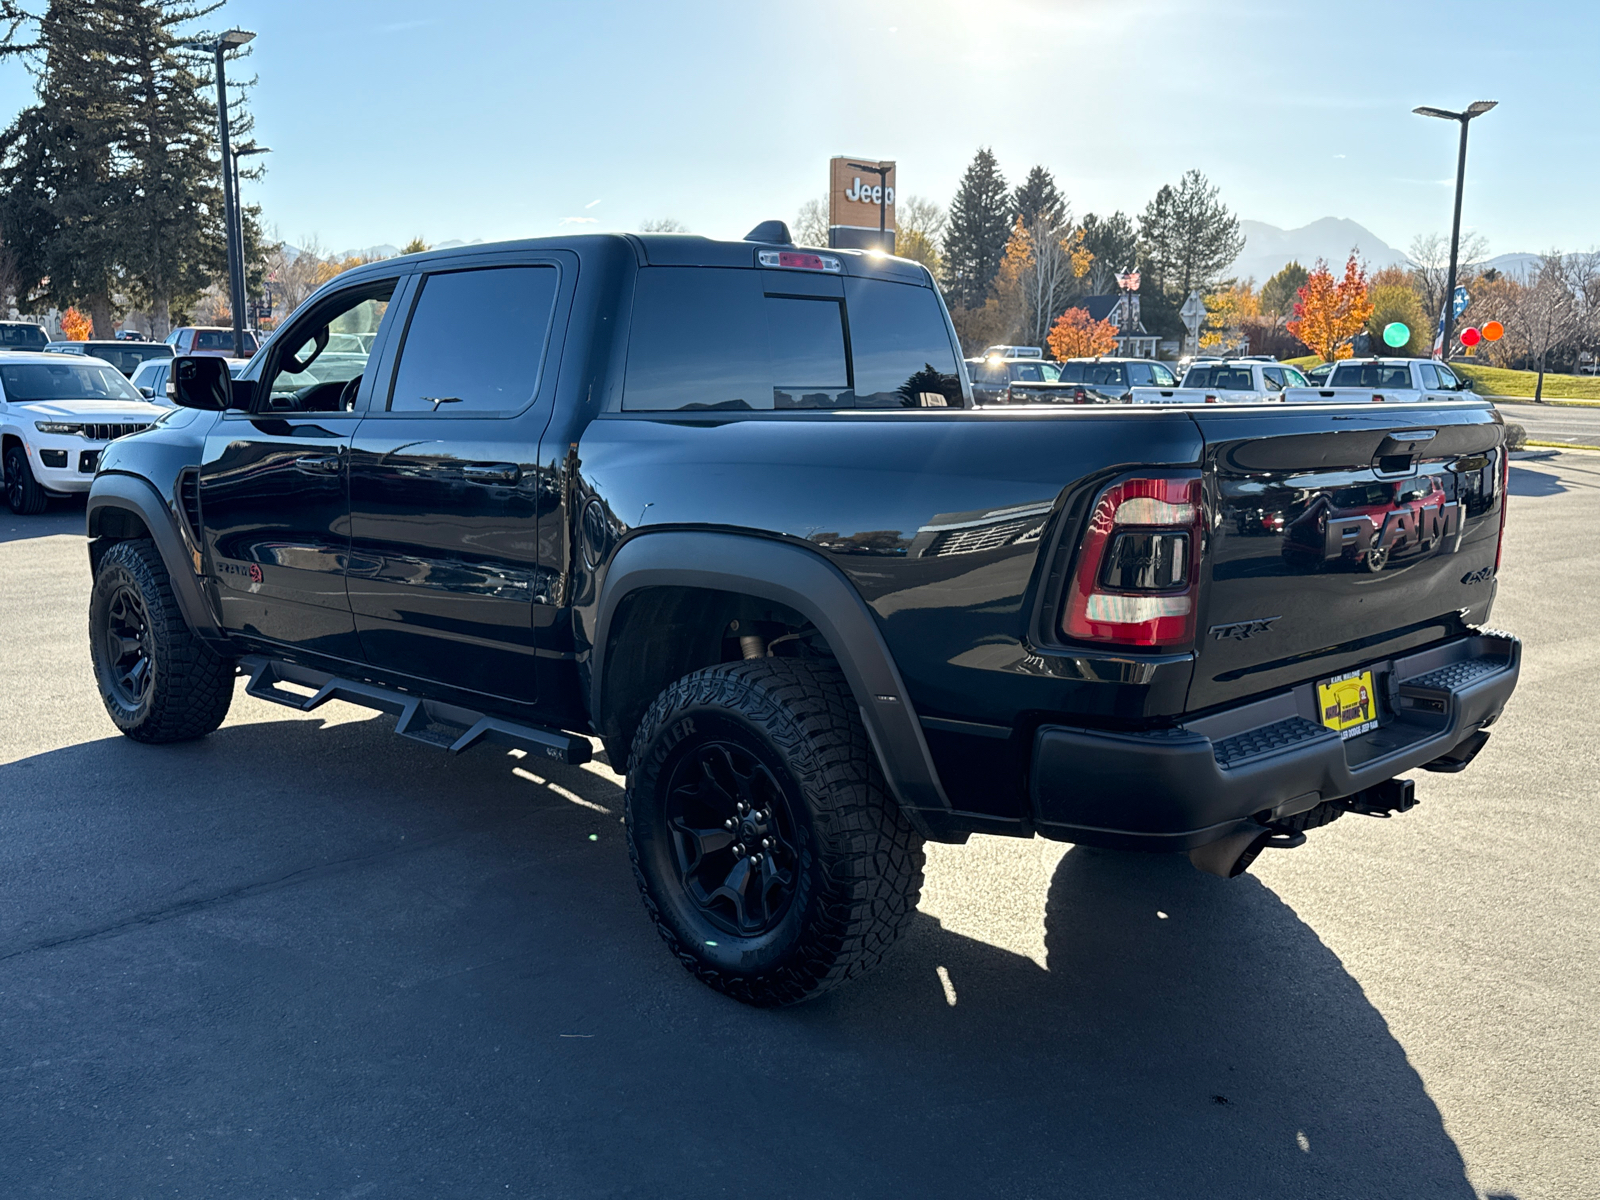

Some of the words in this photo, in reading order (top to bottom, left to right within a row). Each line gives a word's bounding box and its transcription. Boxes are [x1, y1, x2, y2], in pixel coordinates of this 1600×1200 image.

[845, 177, 895, 210] Jeep
[1325, 501, 1459, 559] RAM
[216, 562, 250, 577] RAM
[1207, 615, 1282, 640] TRX
